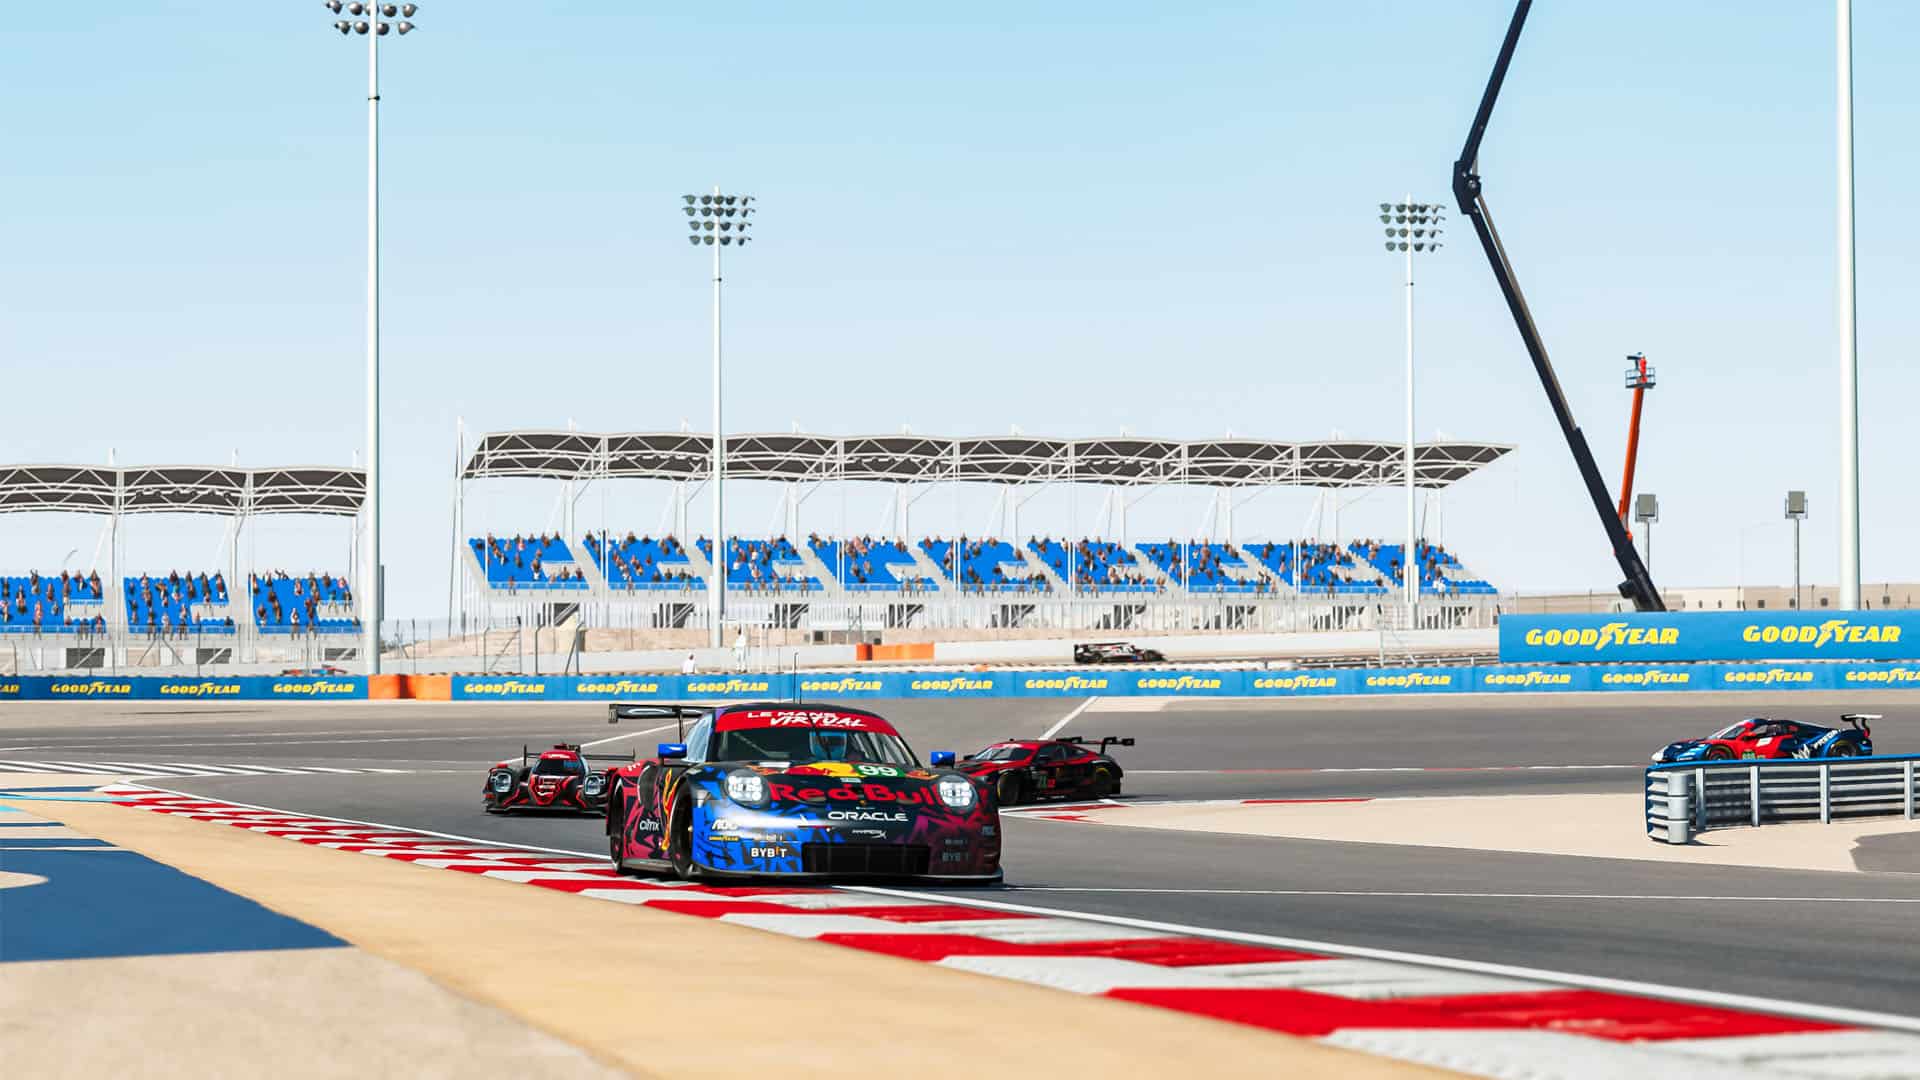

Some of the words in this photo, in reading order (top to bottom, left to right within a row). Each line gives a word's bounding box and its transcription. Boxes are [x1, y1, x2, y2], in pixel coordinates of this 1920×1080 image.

[1525, 622, 1680, 650] GOODYEAR
[1744, 619, 1901, 648] GOODYEAR
[1253, 675, 1337, 689] GOODYEAR
[1366, 673, 1451, 687] GOODYEAR
[1484, 671, 1572, 685] GOODYEAR
[1602, 670, 1690, 685] GOODYEAR
[1724, 668, 1814, 683] GOODYEAR
[51, 681, 131, 695] GOODYEAR
[160, 682, 241, 696] GOODYEAR
[273, 681, 355, 694] GOODYEAR
[463, 680, 545, 694] GOODYEAR
[576, 680, 658, 694] GOODYEAR
[687, 679, 769, 693] GOODYEAR
[800, 678, 882, 692] GOODYEAR
[911, 677, 993, 691] GOODYEAR
[1025, 676, 1108, 690] GOODYEAR
[1137, 676, 1221, 690] GOODYEAR
[858, 764, 898, 778] 99
[768, 782, 858, 801] Red
[863, 783, 944, 806] Bull
[828, 811, 908, 822] ORACLE
